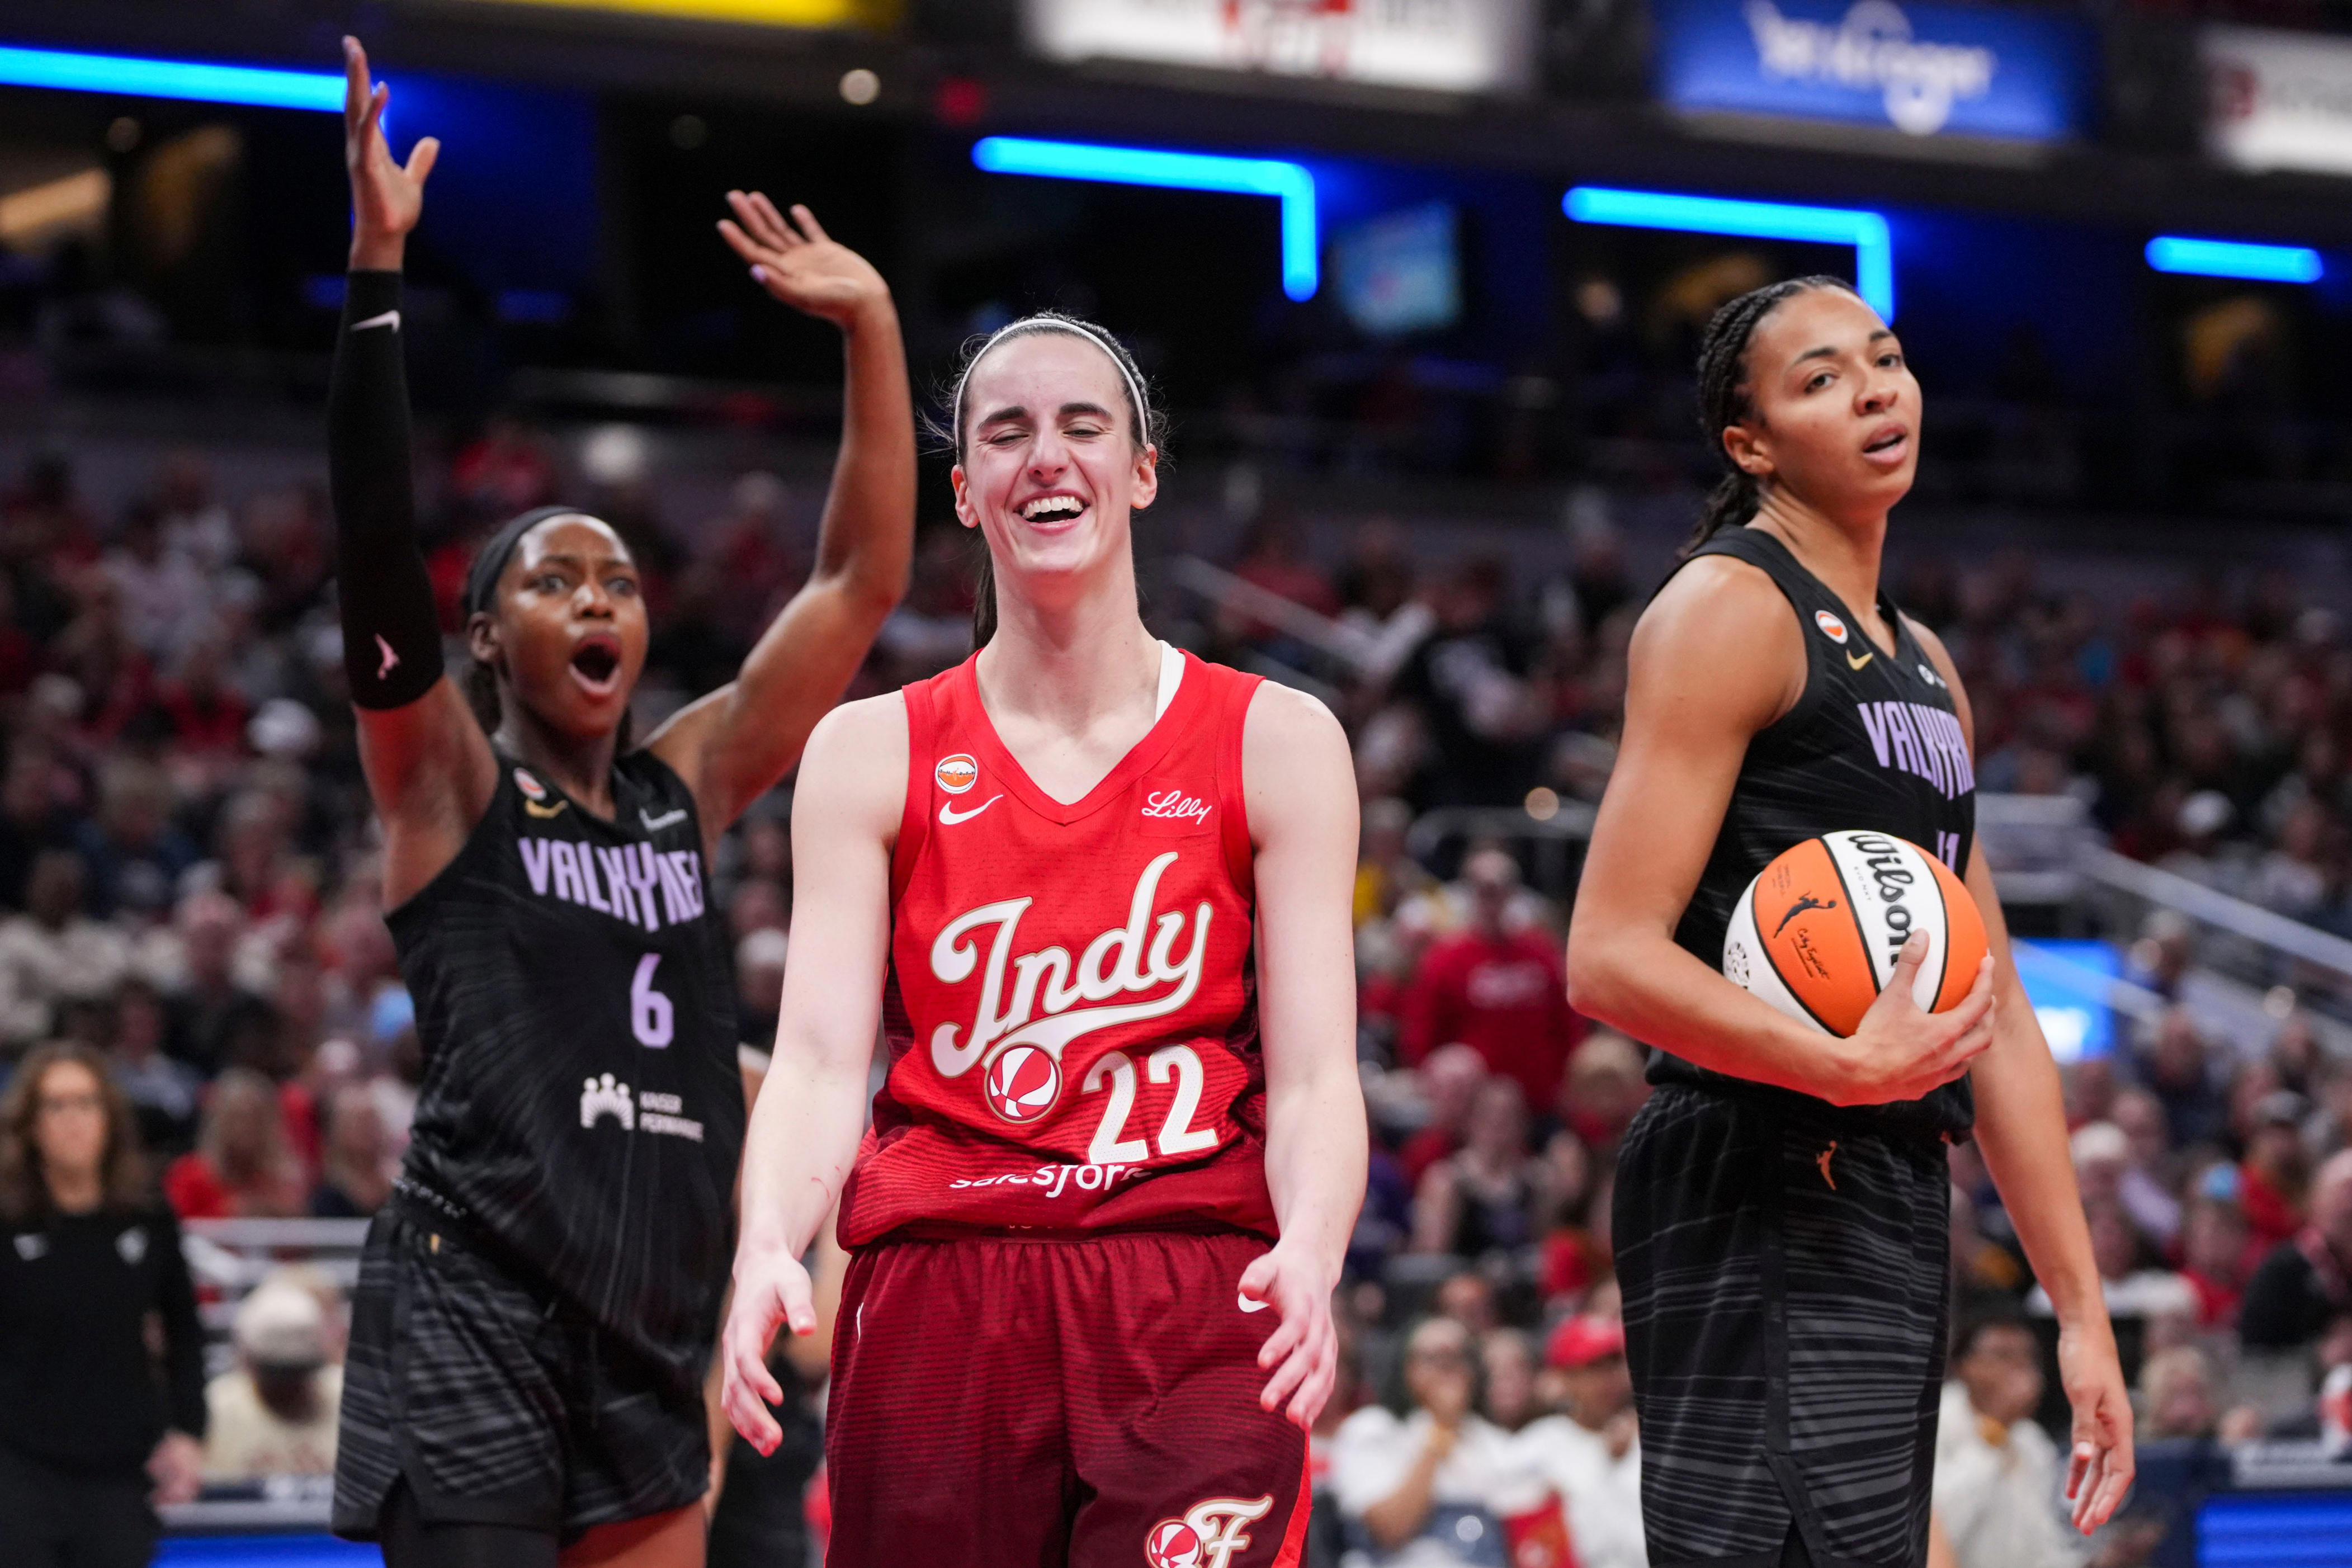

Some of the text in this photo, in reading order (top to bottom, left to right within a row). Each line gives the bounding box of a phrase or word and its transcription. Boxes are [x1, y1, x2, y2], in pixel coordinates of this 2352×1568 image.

[1141, 790, 1212, 825] Lilly
[631, 953, 674, 1050] 6
[931, 852, 1213, 1079] Indy
[1081, 1043, 1218, 1165] 22
